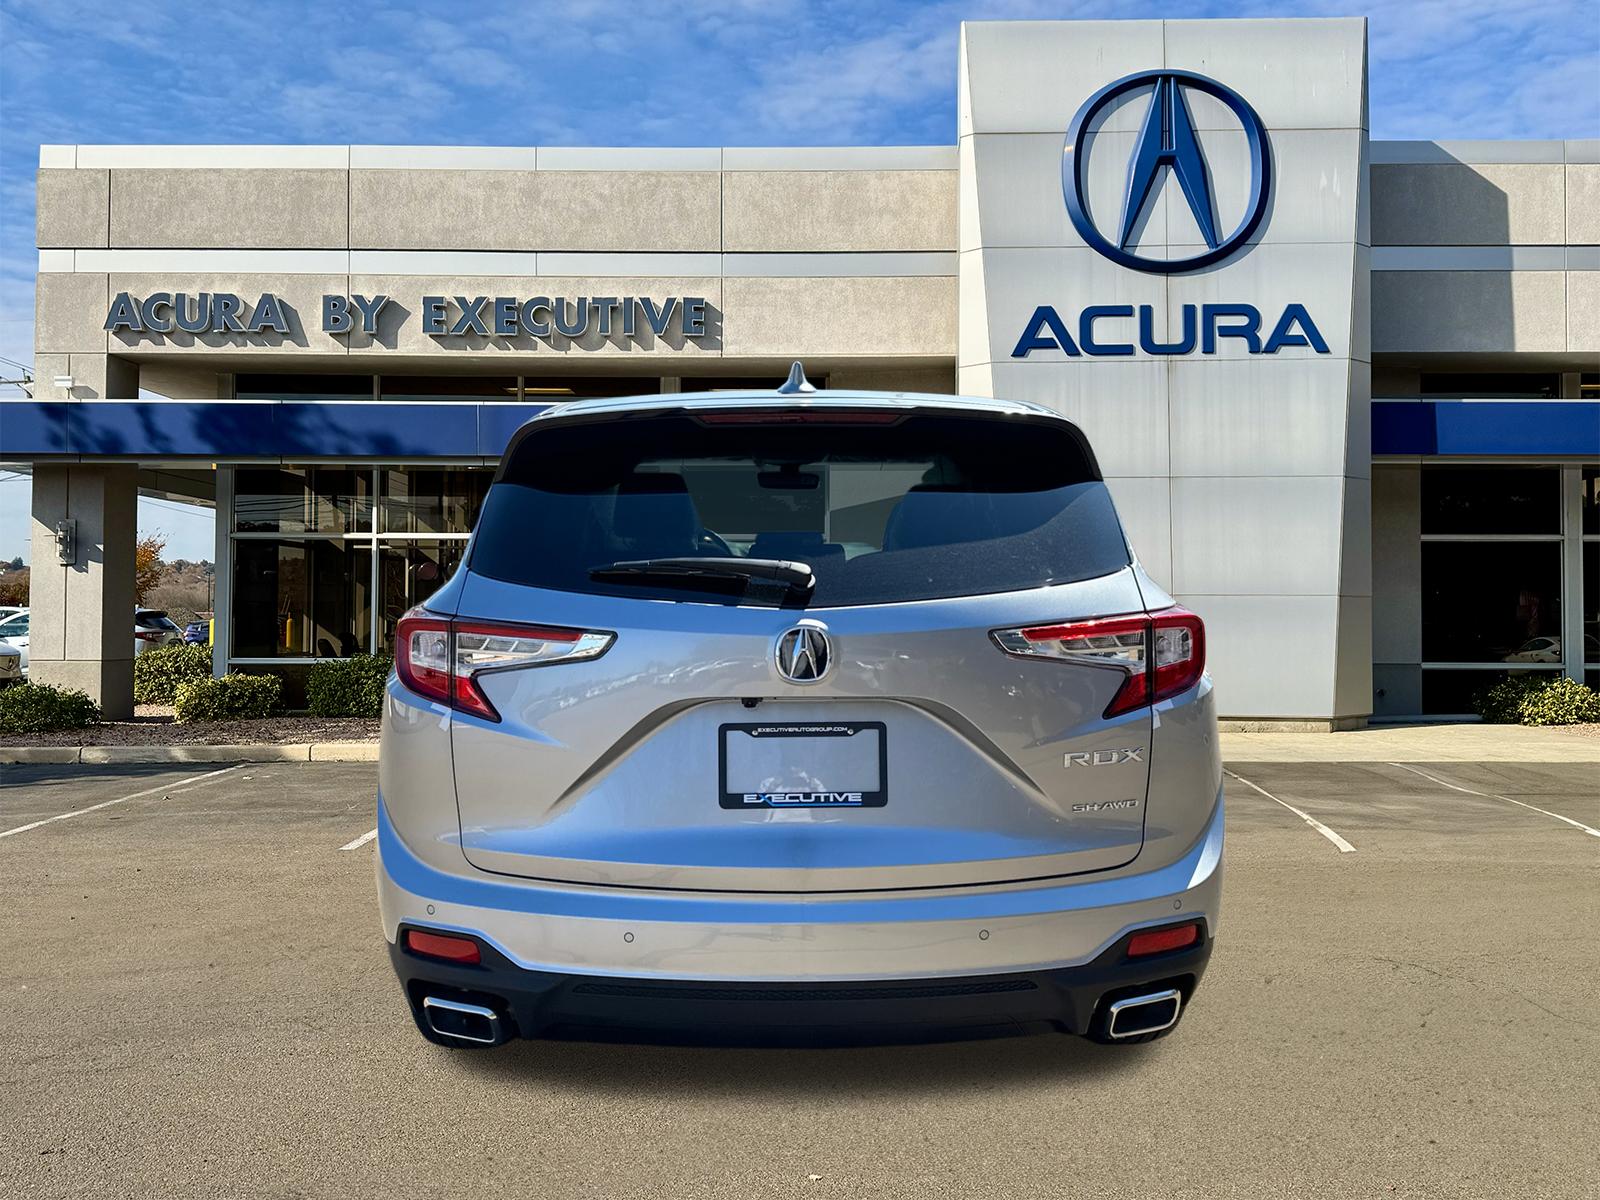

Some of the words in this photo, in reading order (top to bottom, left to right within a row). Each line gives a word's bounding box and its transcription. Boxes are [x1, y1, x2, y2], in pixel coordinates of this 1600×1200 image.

[103, 291, 290, 335] ACURA
[321, 294, 391, 335] BY
[421, 296, 707, 338] EXECUTIVE
[1011, 303, 1332, 358] ACURA
[1063, 746, 1144, 768] RDX
[743, 792, 863, 804] EXECUTIVE
